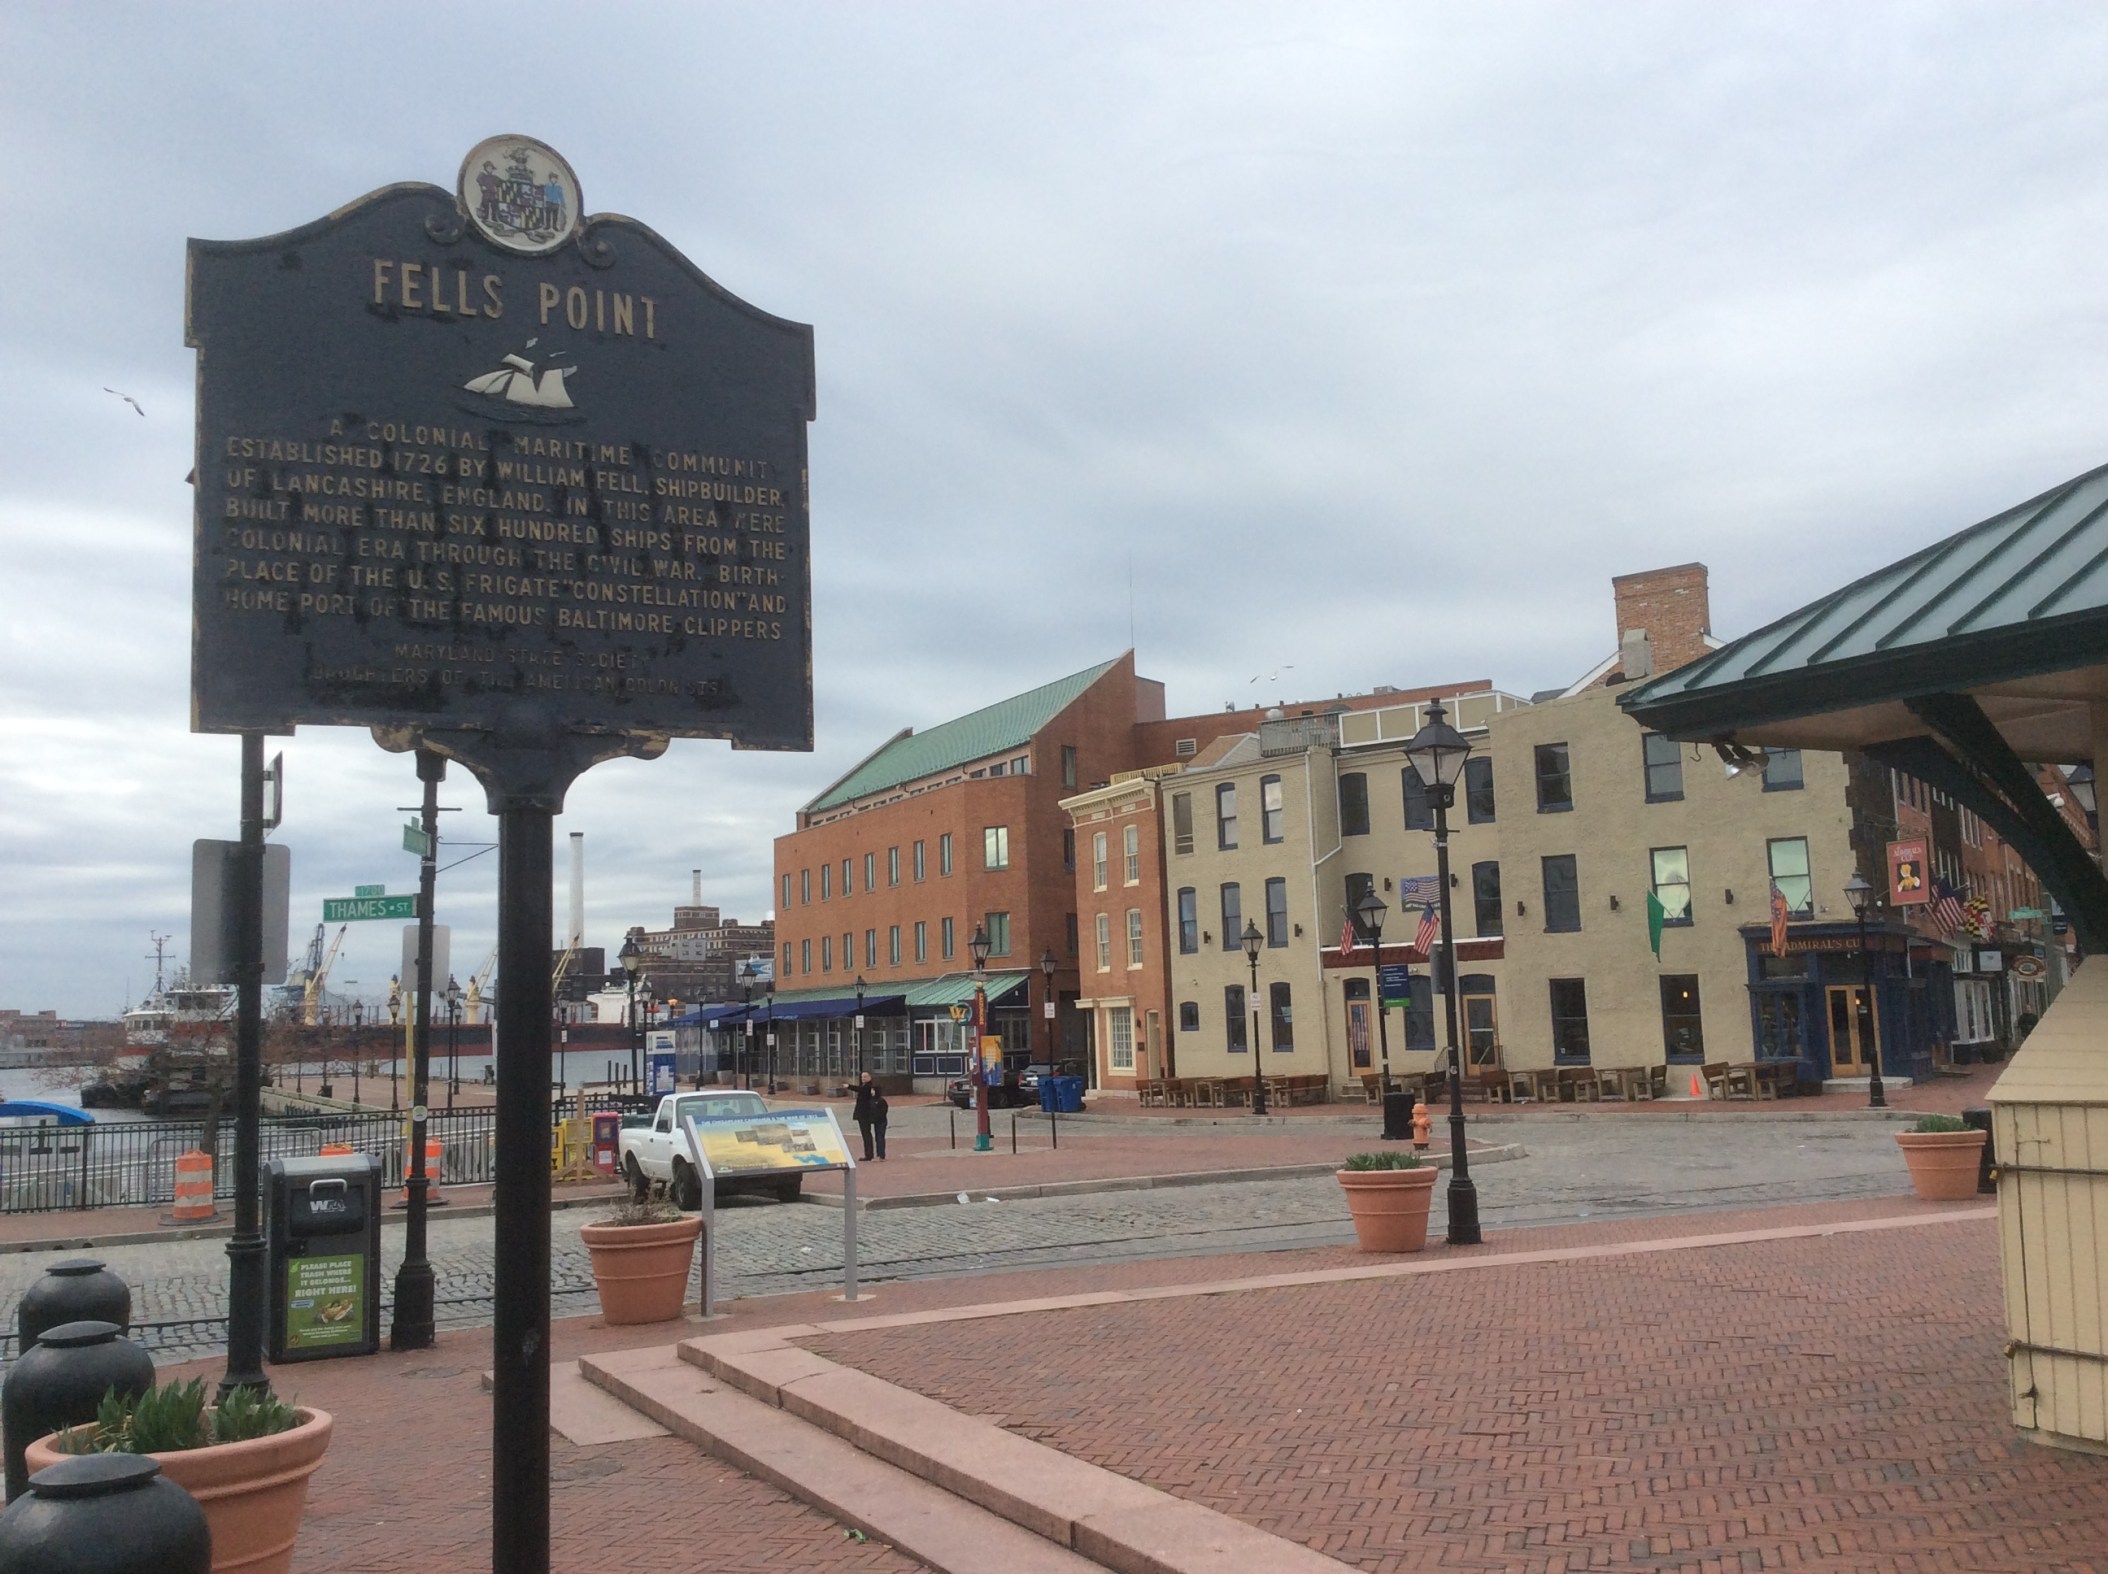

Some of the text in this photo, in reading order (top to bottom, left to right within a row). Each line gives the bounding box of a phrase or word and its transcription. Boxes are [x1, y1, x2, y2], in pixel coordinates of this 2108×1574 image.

[373, 257, 660, 340] FELLS POINT
[227, 435, 383, 469] ESTABLISHED
[394, 452, 448, 475] 1726
[459, 458, 487, 479] BY
[496, 460, 586, 489] WILLIAM
[330, 418, 776, 480] A COLONIAL MARITIME COMMUNIT
[227, 468, 256, 488] OF
[566, 496, 588, 516] IN
[603, 499, 651, 523] THIS
[663, 504, 719, 529] AREA
[225, 498, 786, 561] BUILT MORE THAN SIX HUNDRED SHIPS FROM THE
[359, 537, 406, 560] ERA
[416, 540, 521, 568] THROUGH
[534, 550, 575, 572] THE
[225, 558, 300, 583] PLACE
[309, 562, 338, 584] OF
[350, 564, 395, 589] THE
[465, 574, 560, 601] FRIGATE
[748, 592, 787, 615] AND
[225, 589, 290, 612] HOME
[300, 592, 356, 616] PORT
[370, 596, 399, 617] OF
[408, 598, 451, 621] THE
[462, 602, 546, 627] FAMOUS
[558, 607, 675, 636] BALTIMORE
[395, 642, 496, 663] MARYLAND
[507, 646, 563, 666] STATE
[312, 664, 429, 685] DAUGHERS
[526, 671, 615, 692] AMECAN
[329, 900, 387, 919] THAMES
[1785, 939, 1842, 951] ADMIRAL'S
[1845, 938, 1860, 949] CU
[300, 1260, 352, 1271] PLEASE PLACE
[300, 1267, 352, 1279] TRASH WHERE
[294, 1287, 326, 1298] RIGHT
[300, 1279, 308, 1287] IT
